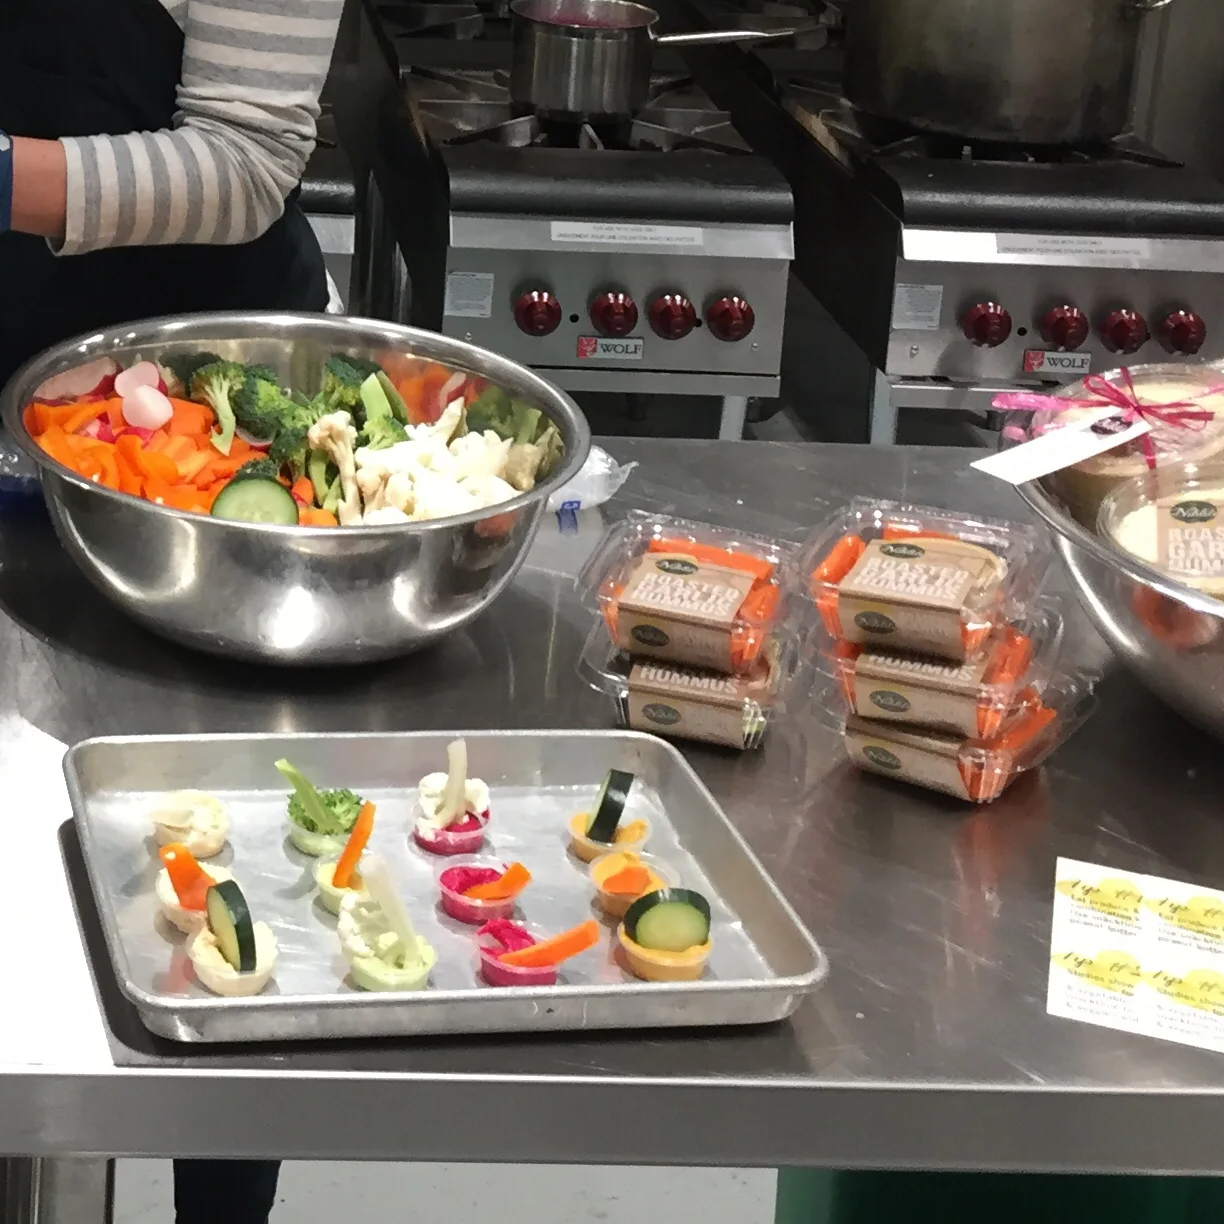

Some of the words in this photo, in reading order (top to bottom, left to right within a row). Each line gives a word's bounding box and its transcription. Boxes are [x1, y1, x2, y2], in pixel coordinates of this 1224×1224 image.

[600, 343, 642, 354] WOLF
[1046, 356, 1090, 369] WOLF
[852, 575, 957, 601] HUMMUS
[631, 589, 730, 617] HUMMUS
[640, 667, 740, 694] HUMMUS
